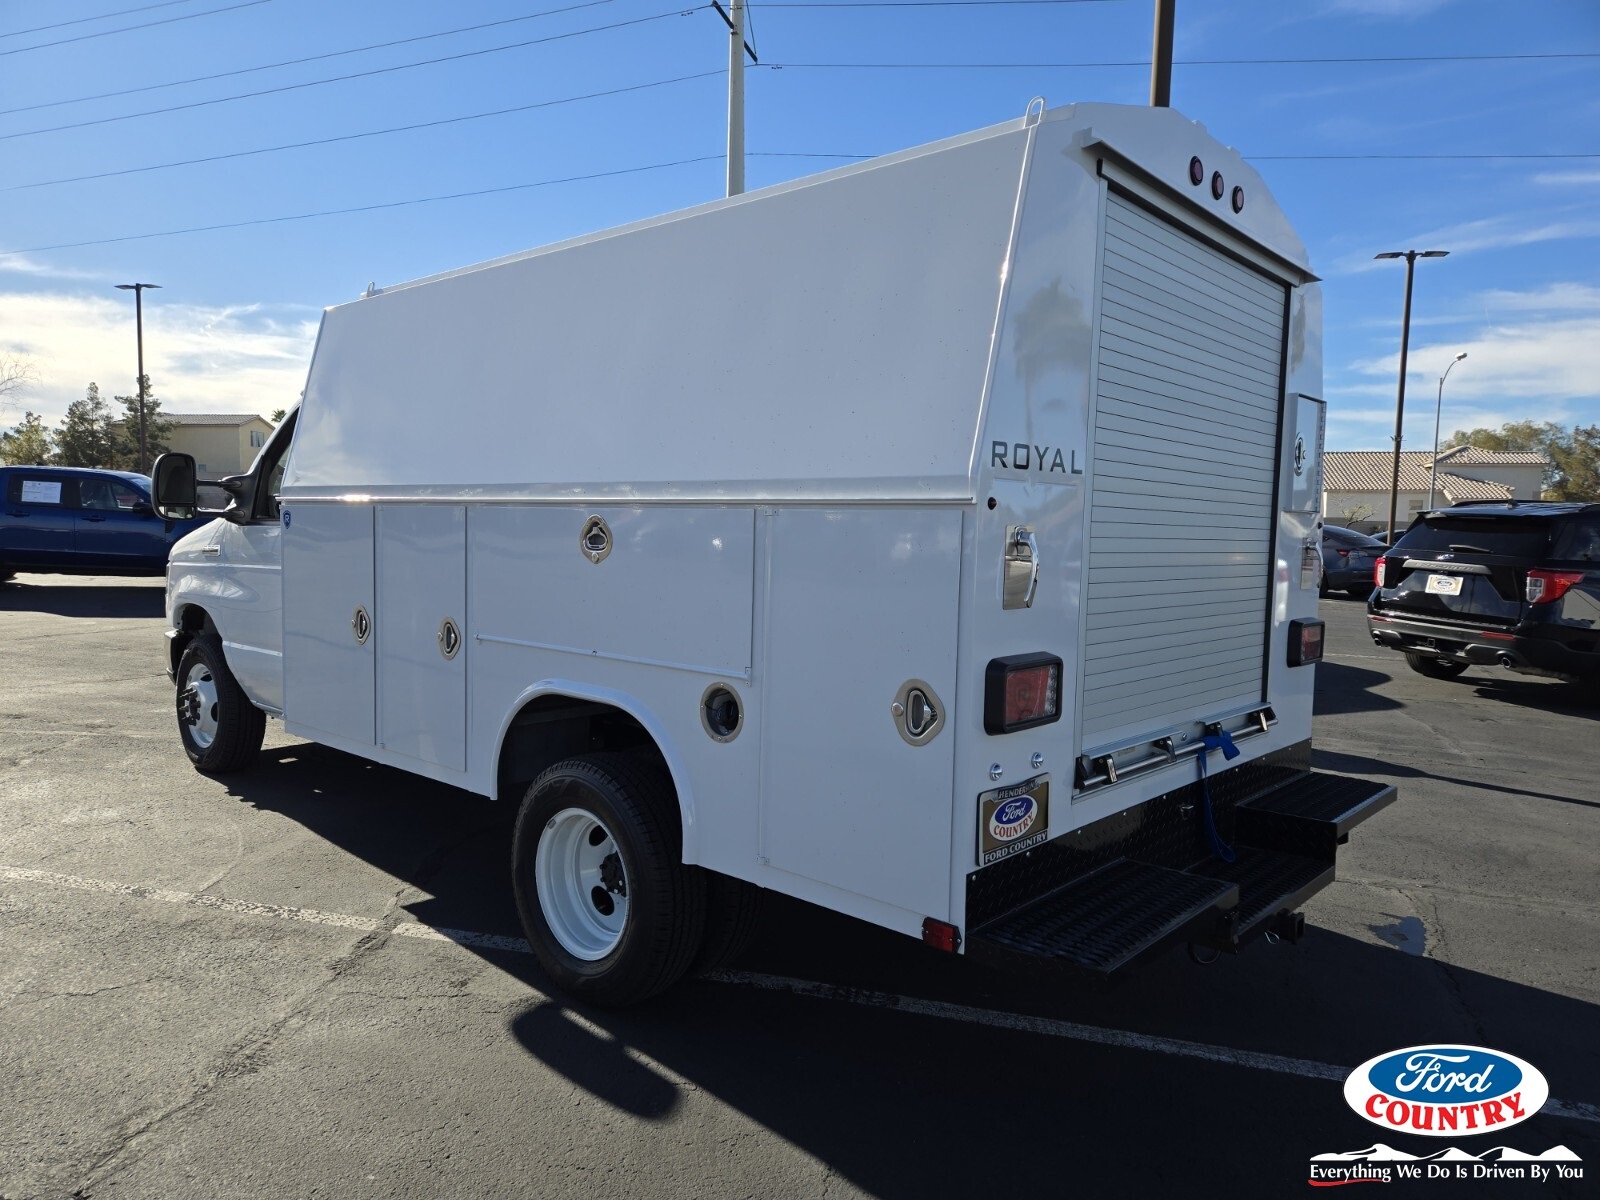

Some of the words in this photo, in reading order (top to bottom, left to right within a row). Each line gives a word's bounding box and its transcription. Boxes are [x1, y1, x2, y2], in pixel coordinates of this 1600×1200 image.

[991, 440, 1083, 475] ROYAL
[994, 810, 1034, 838] COUNTRY
[1002, 801, 1027, 822] Ford
[985, 847, 1008, 863] FORD
[1009, 832, 1048, 854] COUNTRY
